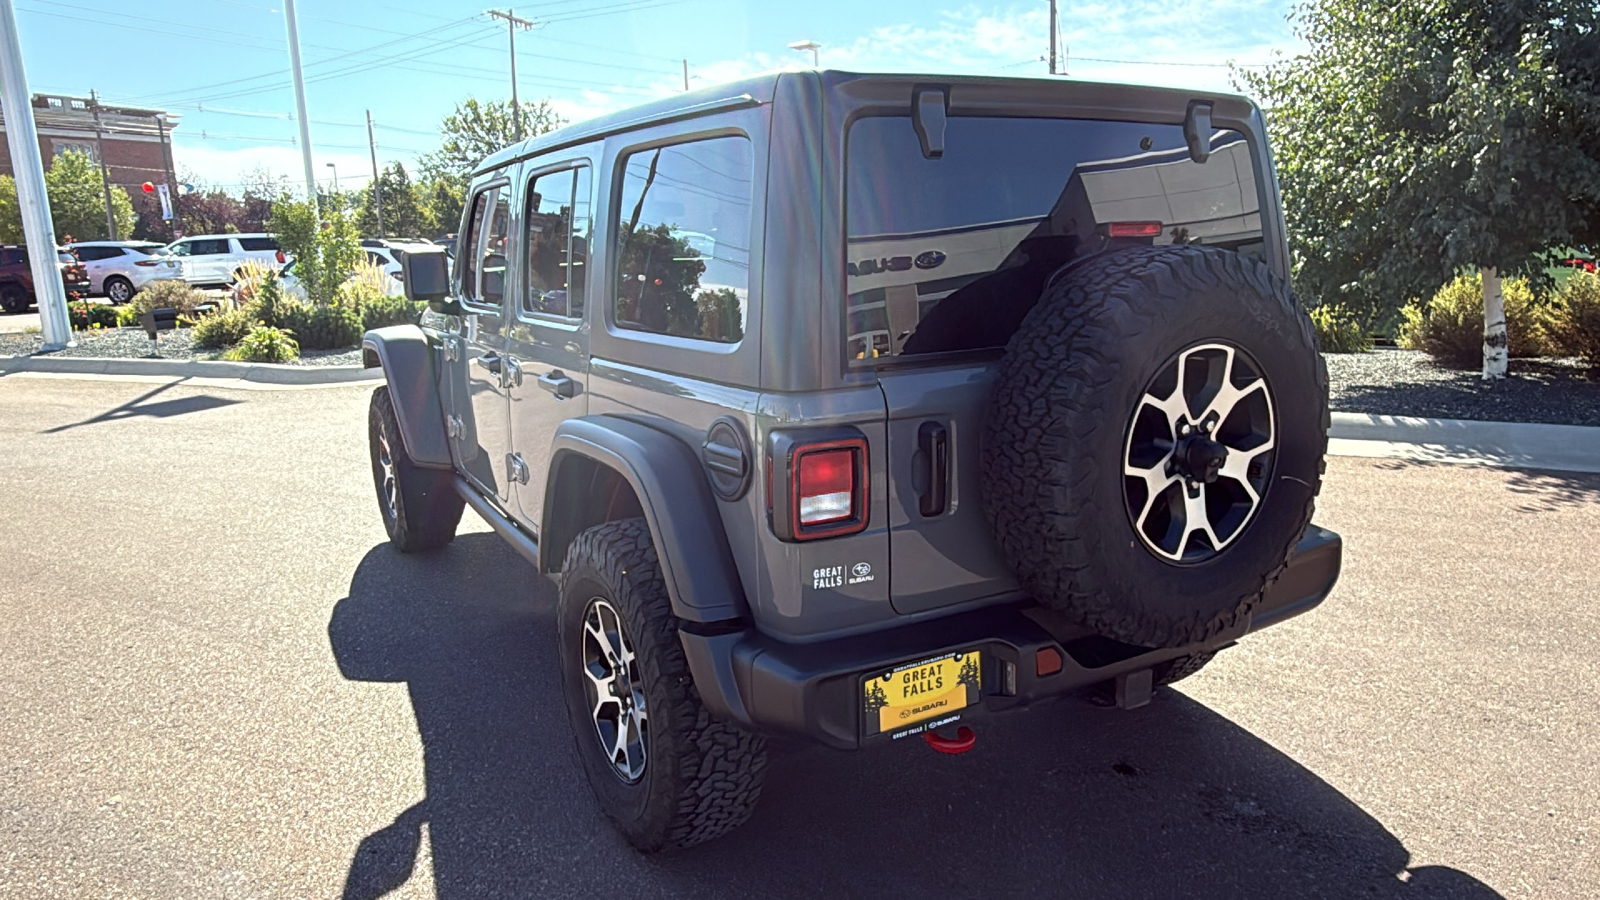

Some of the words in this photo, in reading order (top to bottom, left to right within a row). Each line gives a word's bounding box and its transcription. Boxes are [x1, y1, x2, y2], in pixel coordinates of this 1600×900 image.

[813, 566, 842, 578] GREAT
[849, 575, 874, 584] SUBARU
[813, 576, 843, 589] FALLS
[903, 664, 943, 684] GREAT
[903, 677, 943, 698] FALLS
[912, 699, 948, 715] SUBARU
[892, 730, 908, 740] GREAT
[908, 726, 923, 735] FALLS
[937, 714, 961, 726] SUBARU
